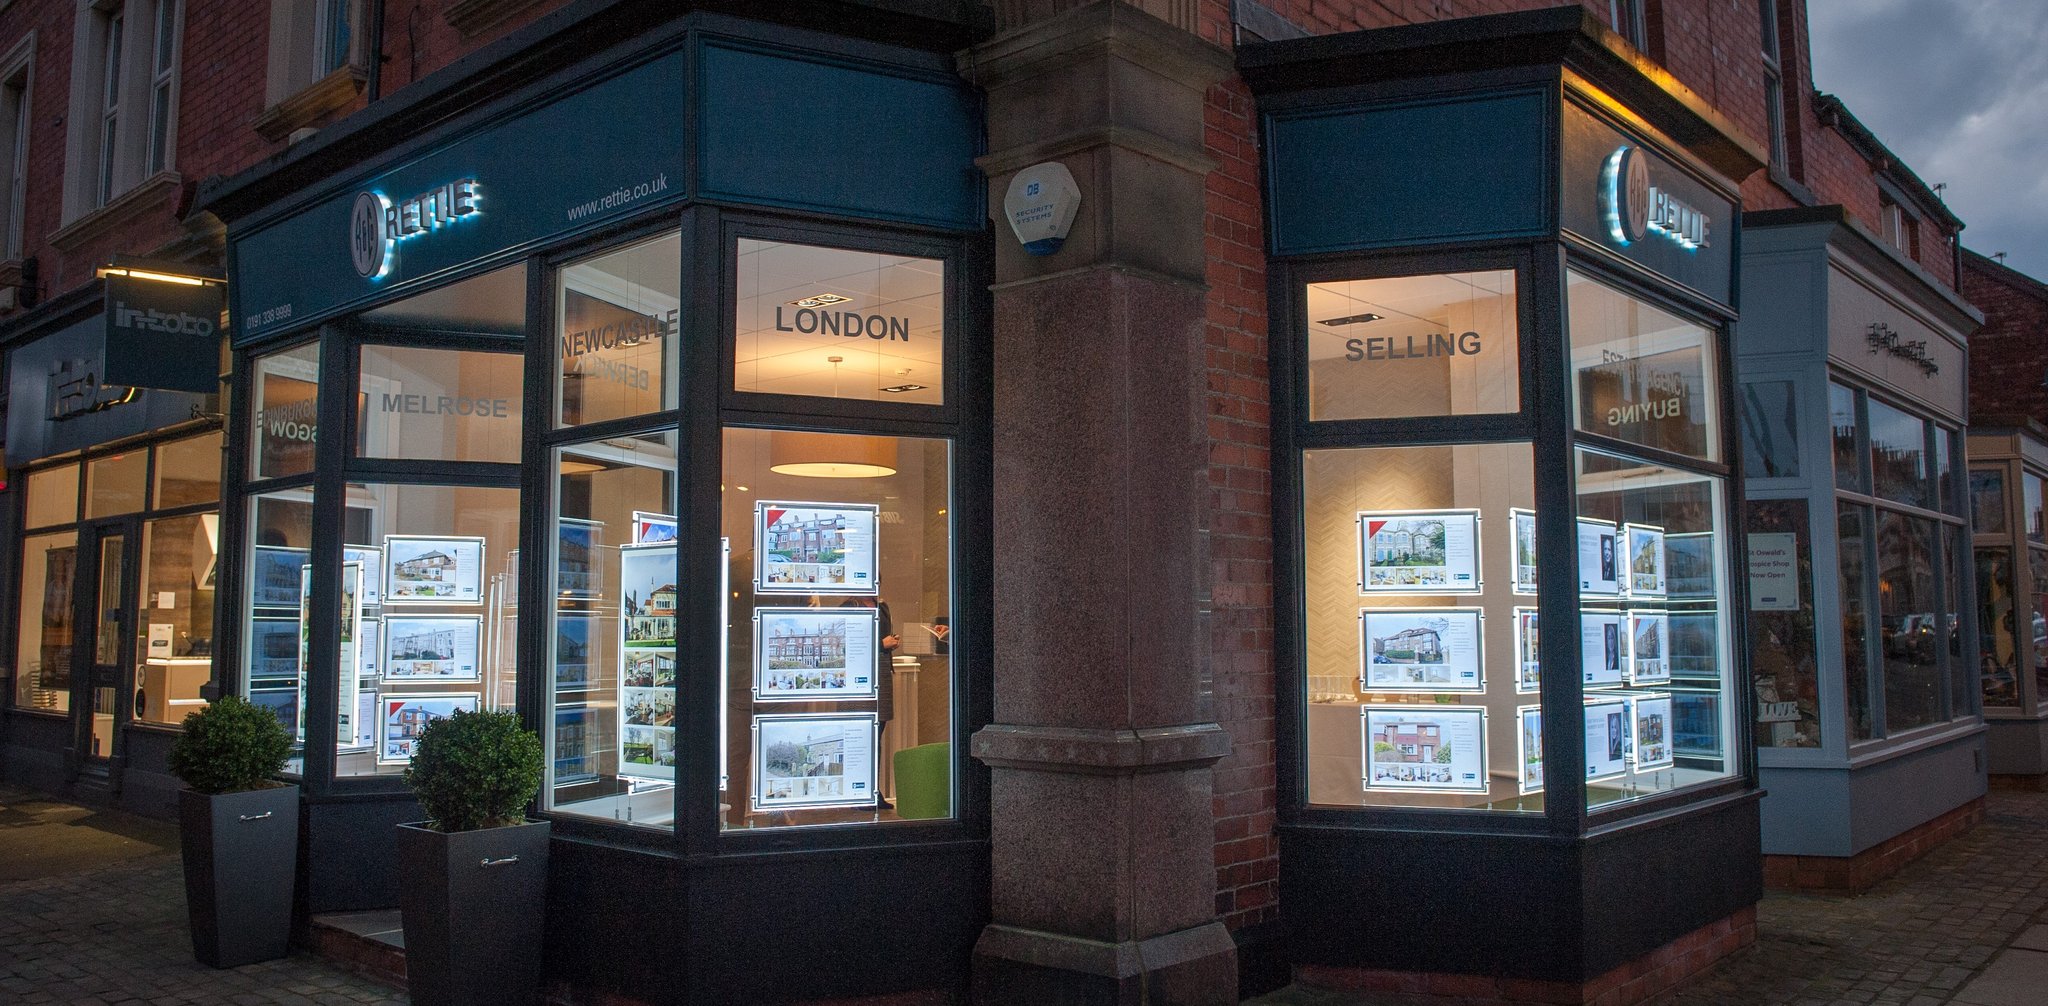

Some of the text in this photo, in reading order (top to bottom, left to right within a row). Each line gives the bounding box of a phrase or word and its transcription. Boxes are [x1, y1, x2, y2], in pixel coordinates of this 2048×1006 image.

[567, 173, 668, 221] www.rettie.co.uk
[1027, 183, 1039, 196] DB
[386, 178, 481, 240] RETTIE
[1015, 204, 1054, 217] SECURITY
[1016, 213, 1052, 224] SYSTEMS
[247, 304, 292, 330] 0191 338 9999
[776, 306, 909, 343] LONDON
[562, 308, 678, 359] NEWCASTLE
[1345, 332, 1482, 362] SELLING
[382, 393, 507, 418] MELROSE
[1750, 561, 1790, 569] ospice Shop
